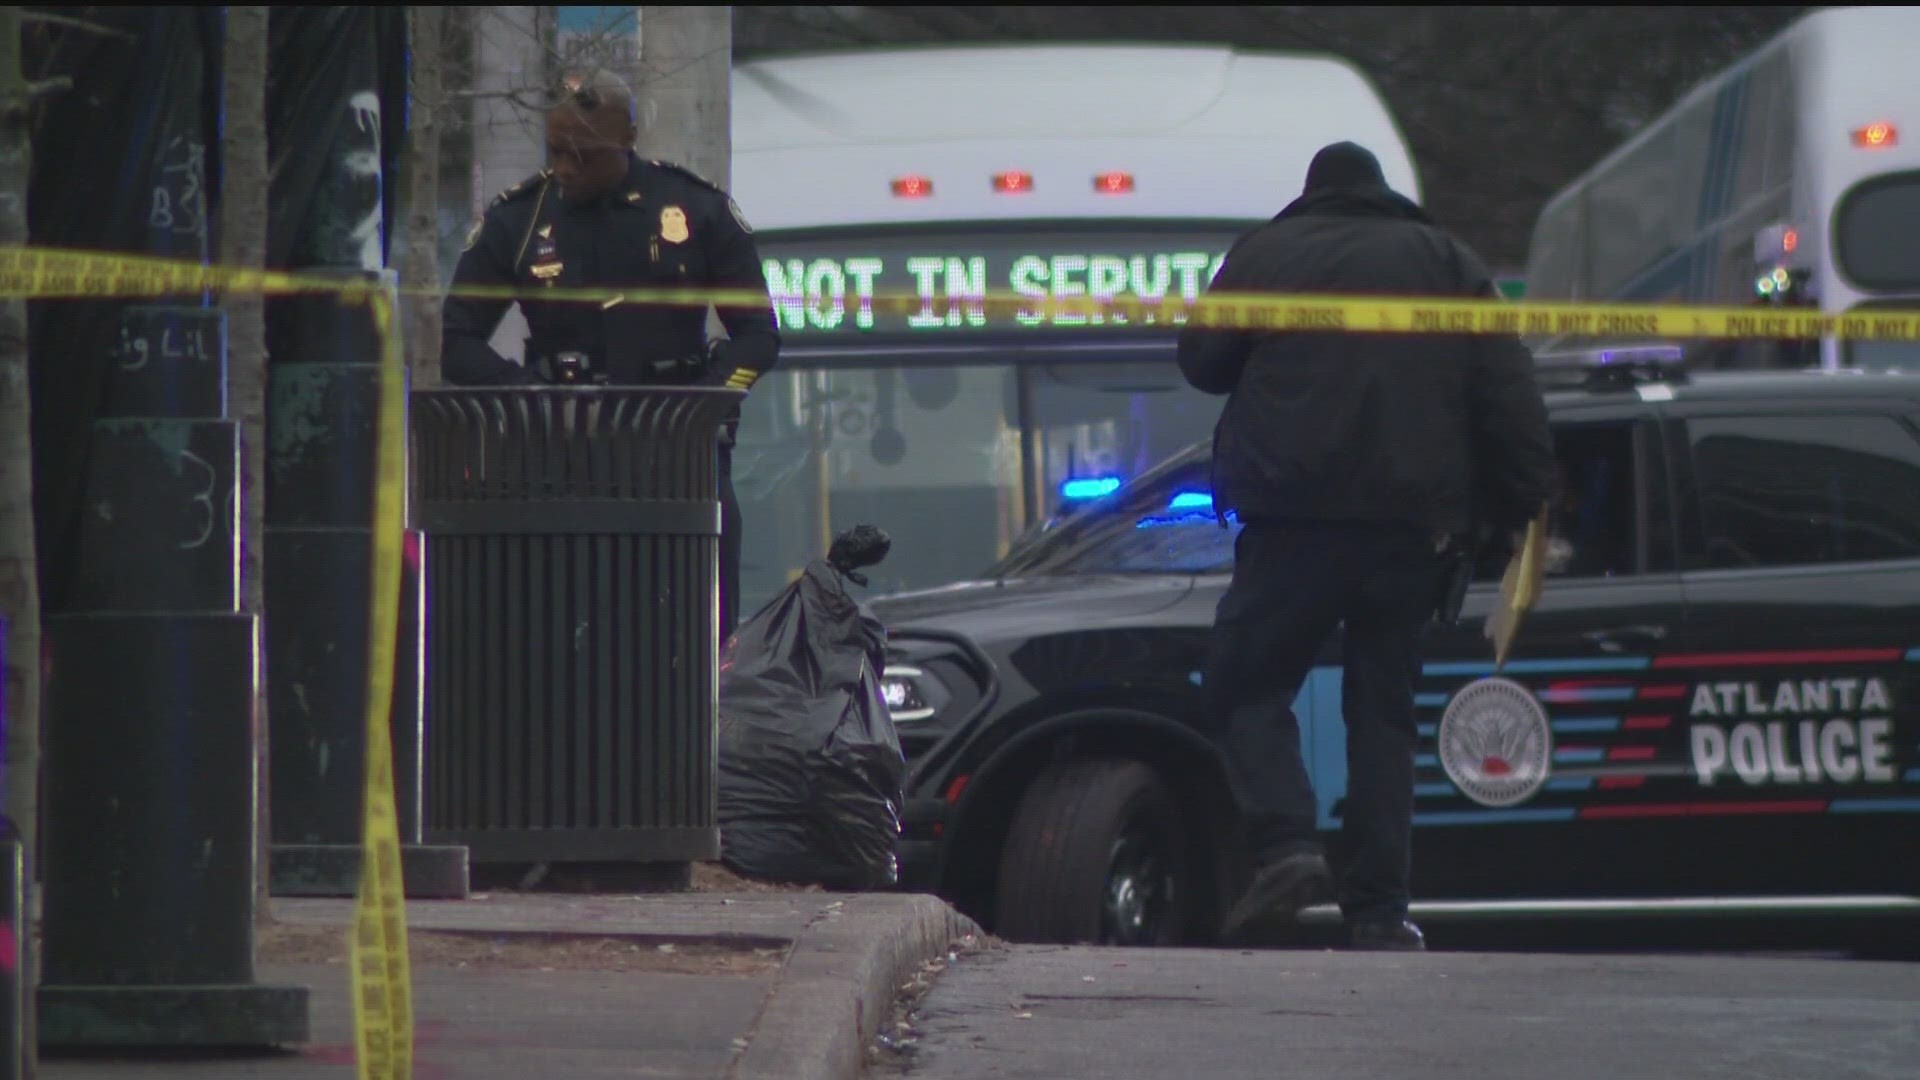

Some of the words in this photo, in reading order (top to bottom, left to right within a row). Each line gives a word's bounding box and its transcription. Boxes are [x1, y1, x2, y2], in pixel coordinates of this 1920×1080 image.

[763, 258, 882, 328] NOT
[907, 256, 986, 326] IN
[1010, 253, 1226, 324] SERVI
[1288, 306, 1345, 331] CROSS
[1411, 308, 1474, 332] POLICE
[1556, 311, 1592, 335] NOT
[1598, 312, 1659, 336] CROSS
[1726, 314, 1789, 337] POLICE
[1873, 317, 1907, 341] NOT
[1690, 678, 1888, 716] ATLANTA
[1690, 719, 1895, 784] POLICE
